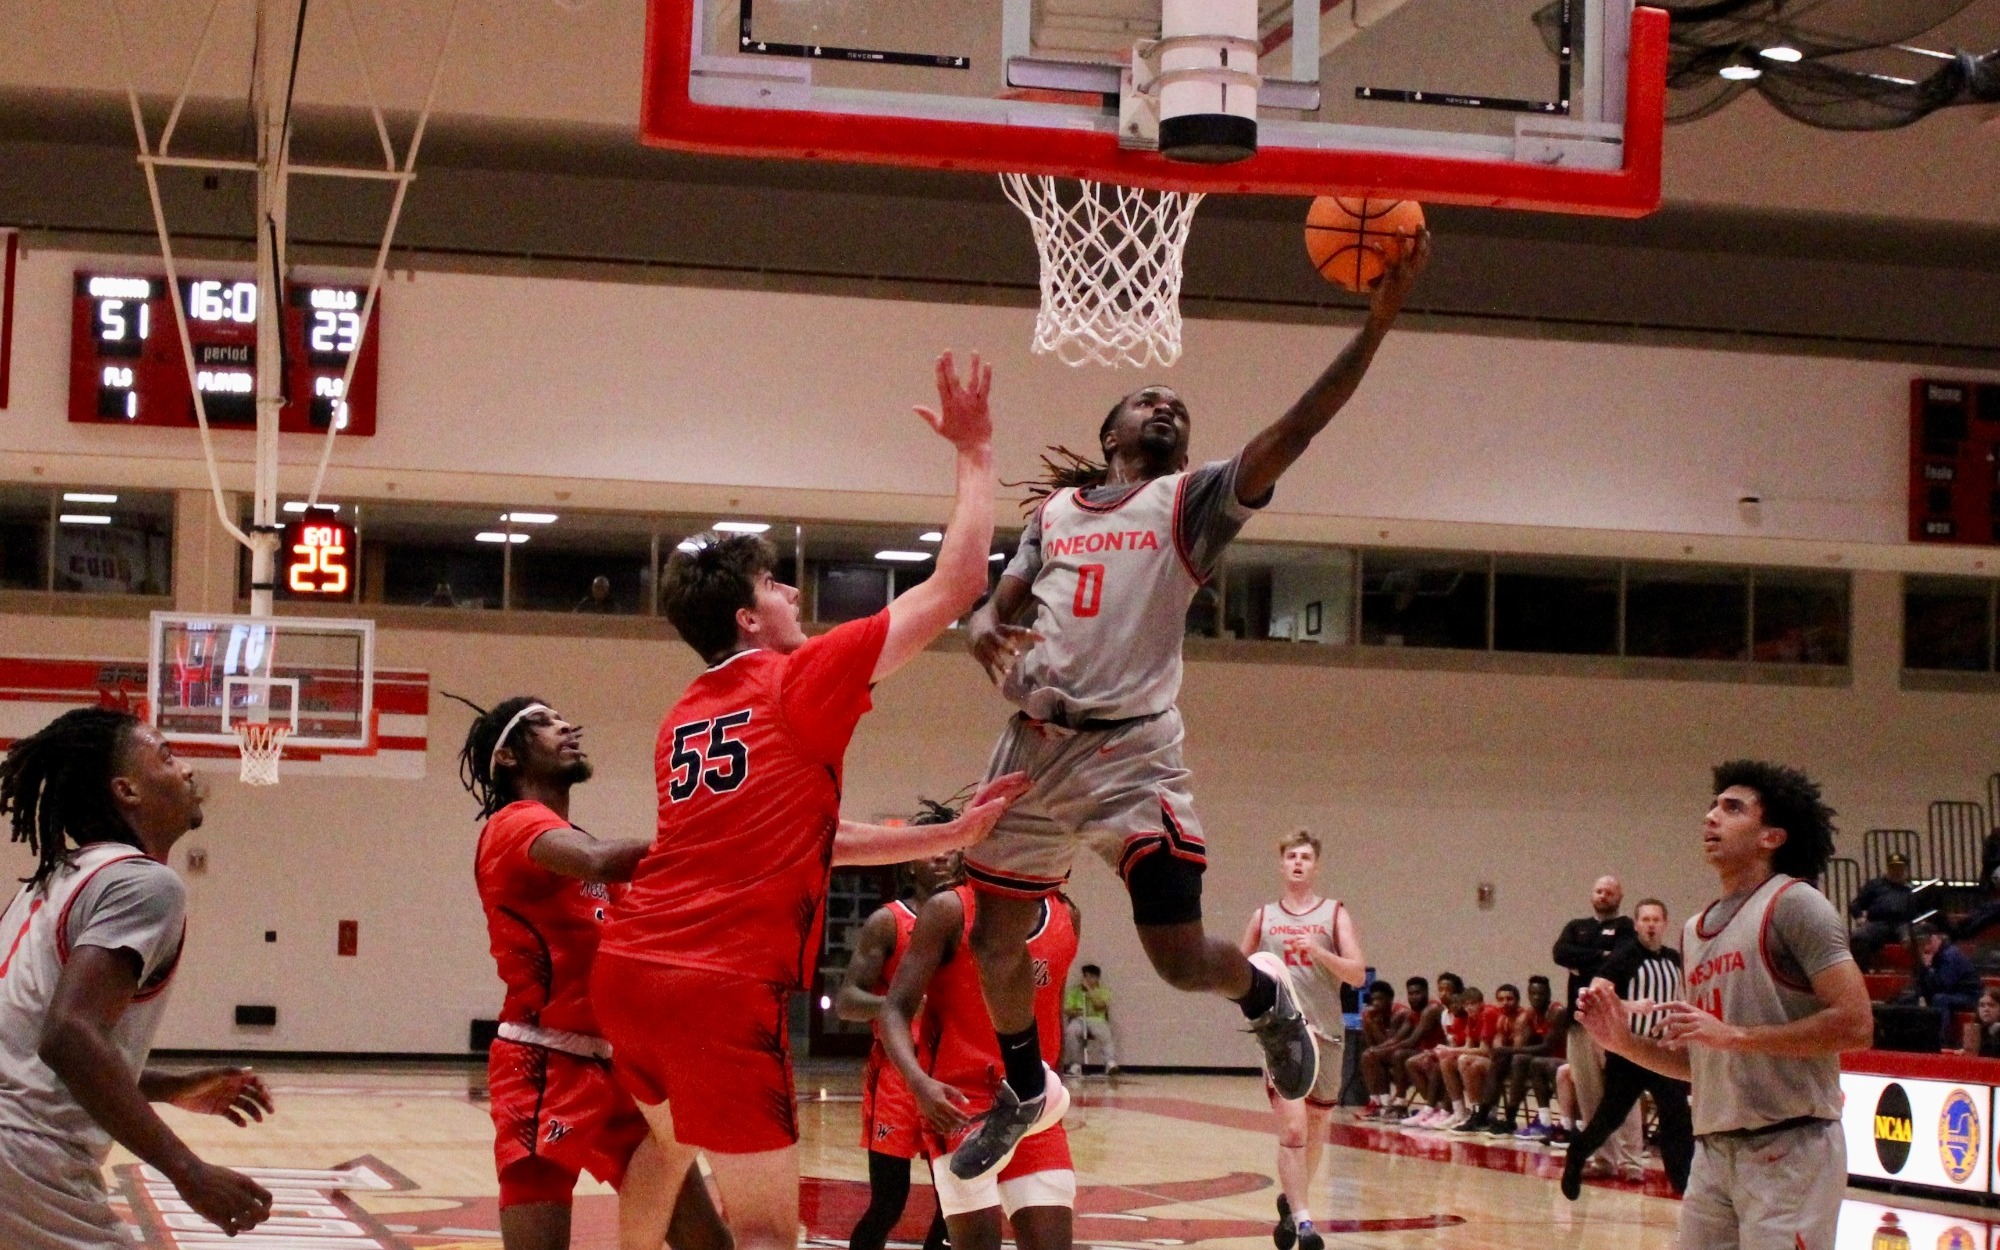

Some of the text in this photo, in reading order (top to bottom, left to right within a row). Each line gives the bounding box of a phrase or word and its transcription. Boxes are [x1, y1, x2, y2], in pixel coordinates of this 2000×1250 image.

[100, 299, 149, 340] 51
[312, 311, 360, 352] 23
[203, 346, 249, 362] period
[289, 544, 347, 593] 25
[1072, 563, 1106, 618] 0
[669, 707, 752, 804] 55
[1875, 1115, 1913, 1143] NCAA
